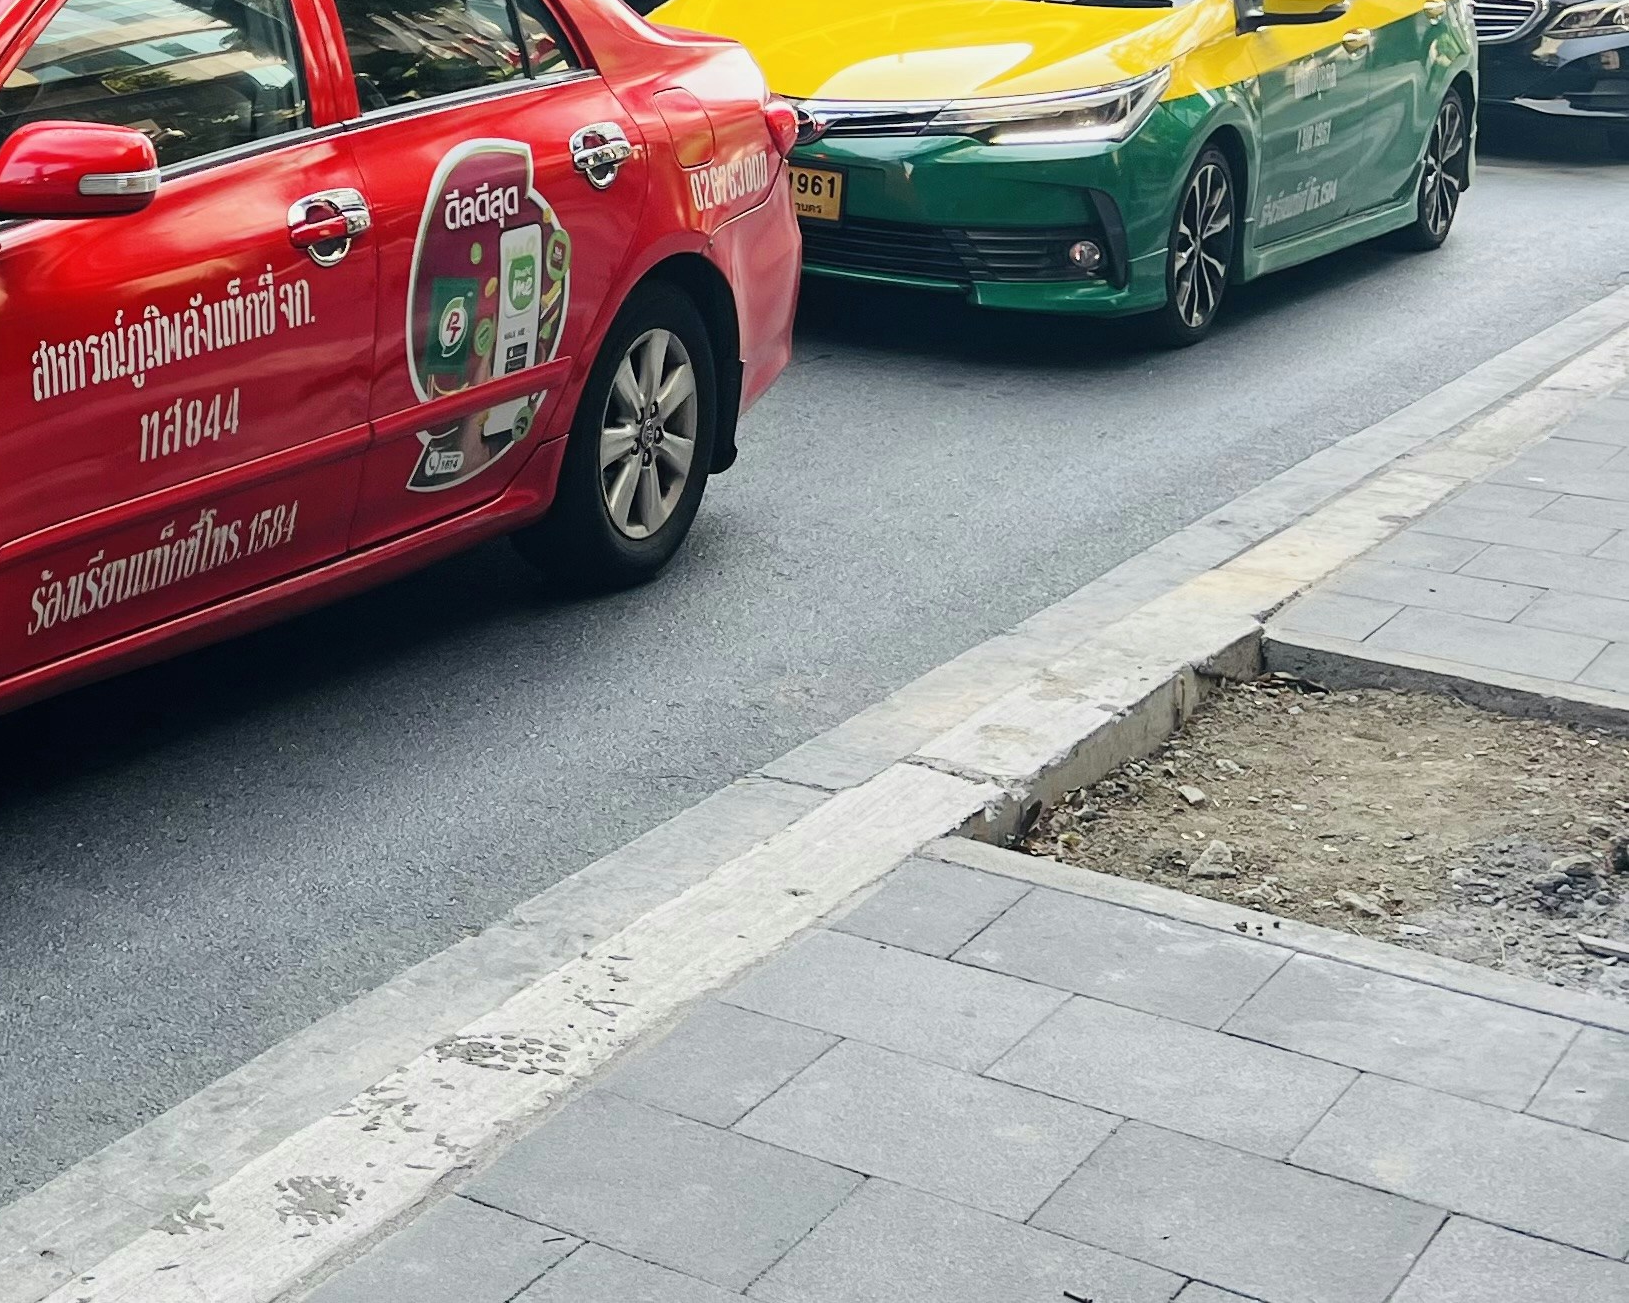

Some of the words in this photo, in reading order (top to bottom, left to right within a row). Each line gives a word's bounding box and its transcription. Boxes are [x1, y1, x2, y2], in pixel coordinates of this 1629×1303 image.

[444, 182, 520, 231] ดีลดีสุด
[32, 265, 276, 402] สหกรณ์ภูมิพลังแท็กซี่
[279, 278, 316, 329] จก.
